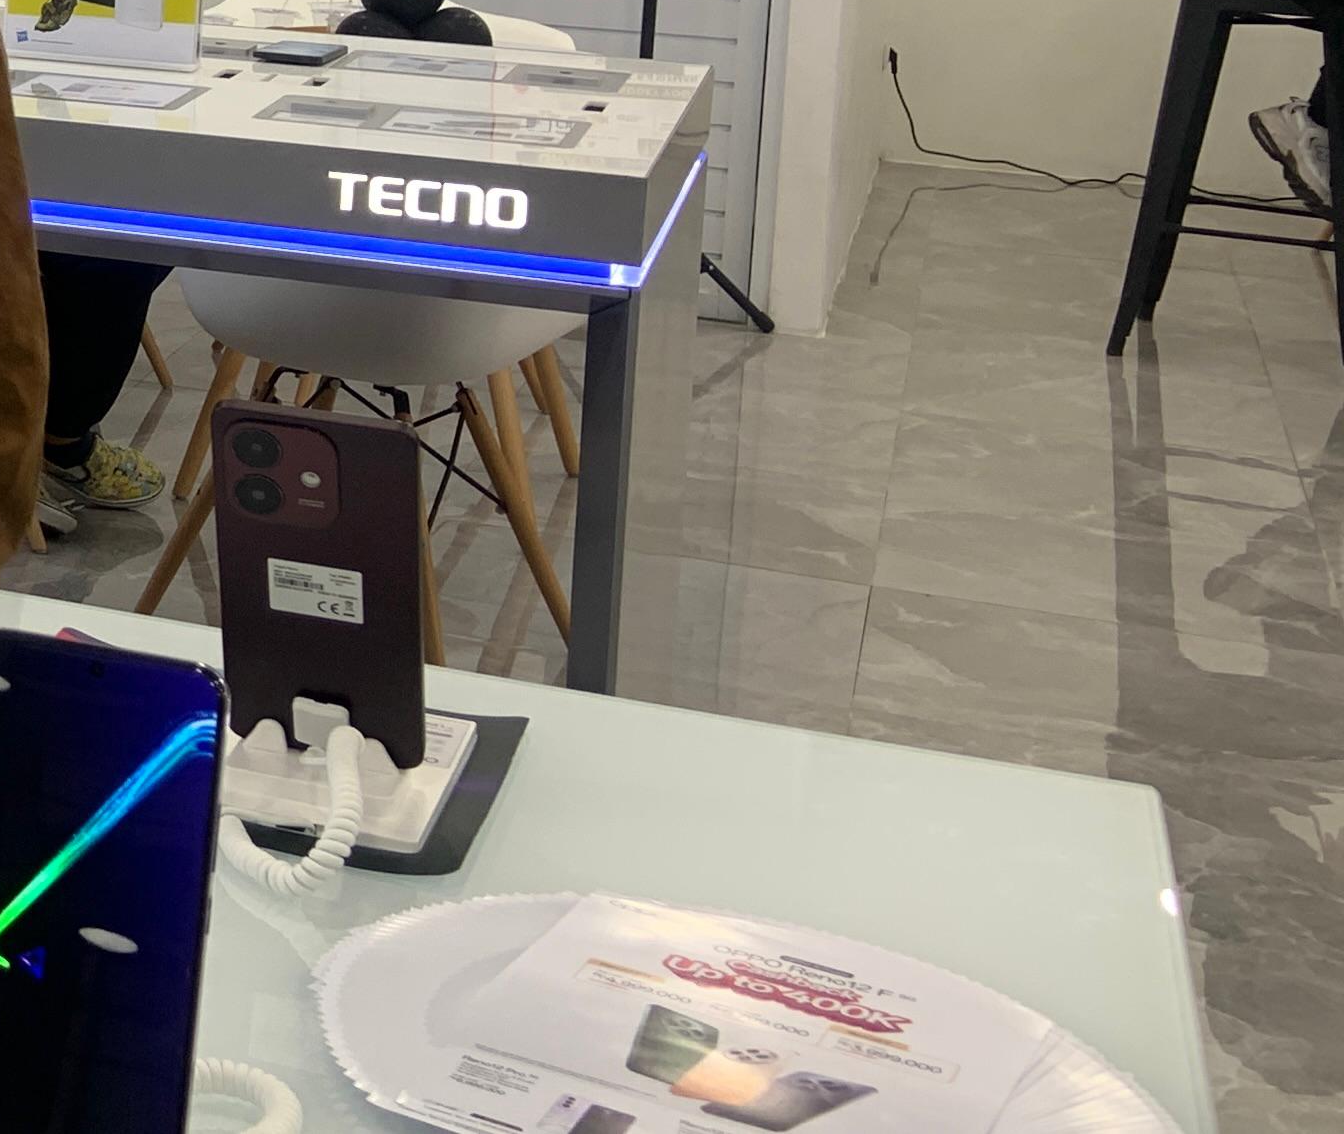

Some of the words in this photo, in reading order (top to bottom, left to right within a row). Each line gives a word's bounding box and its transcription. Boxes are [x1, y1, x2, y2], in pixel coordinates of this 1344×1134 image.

[328, 170, 528, 230] TECNO
[713, 944, 785, 970] OPPO
[666, 954, 724, 982] Up
[733, 973, 774, 994] to
[778, 986, 912, 1032] 400K
